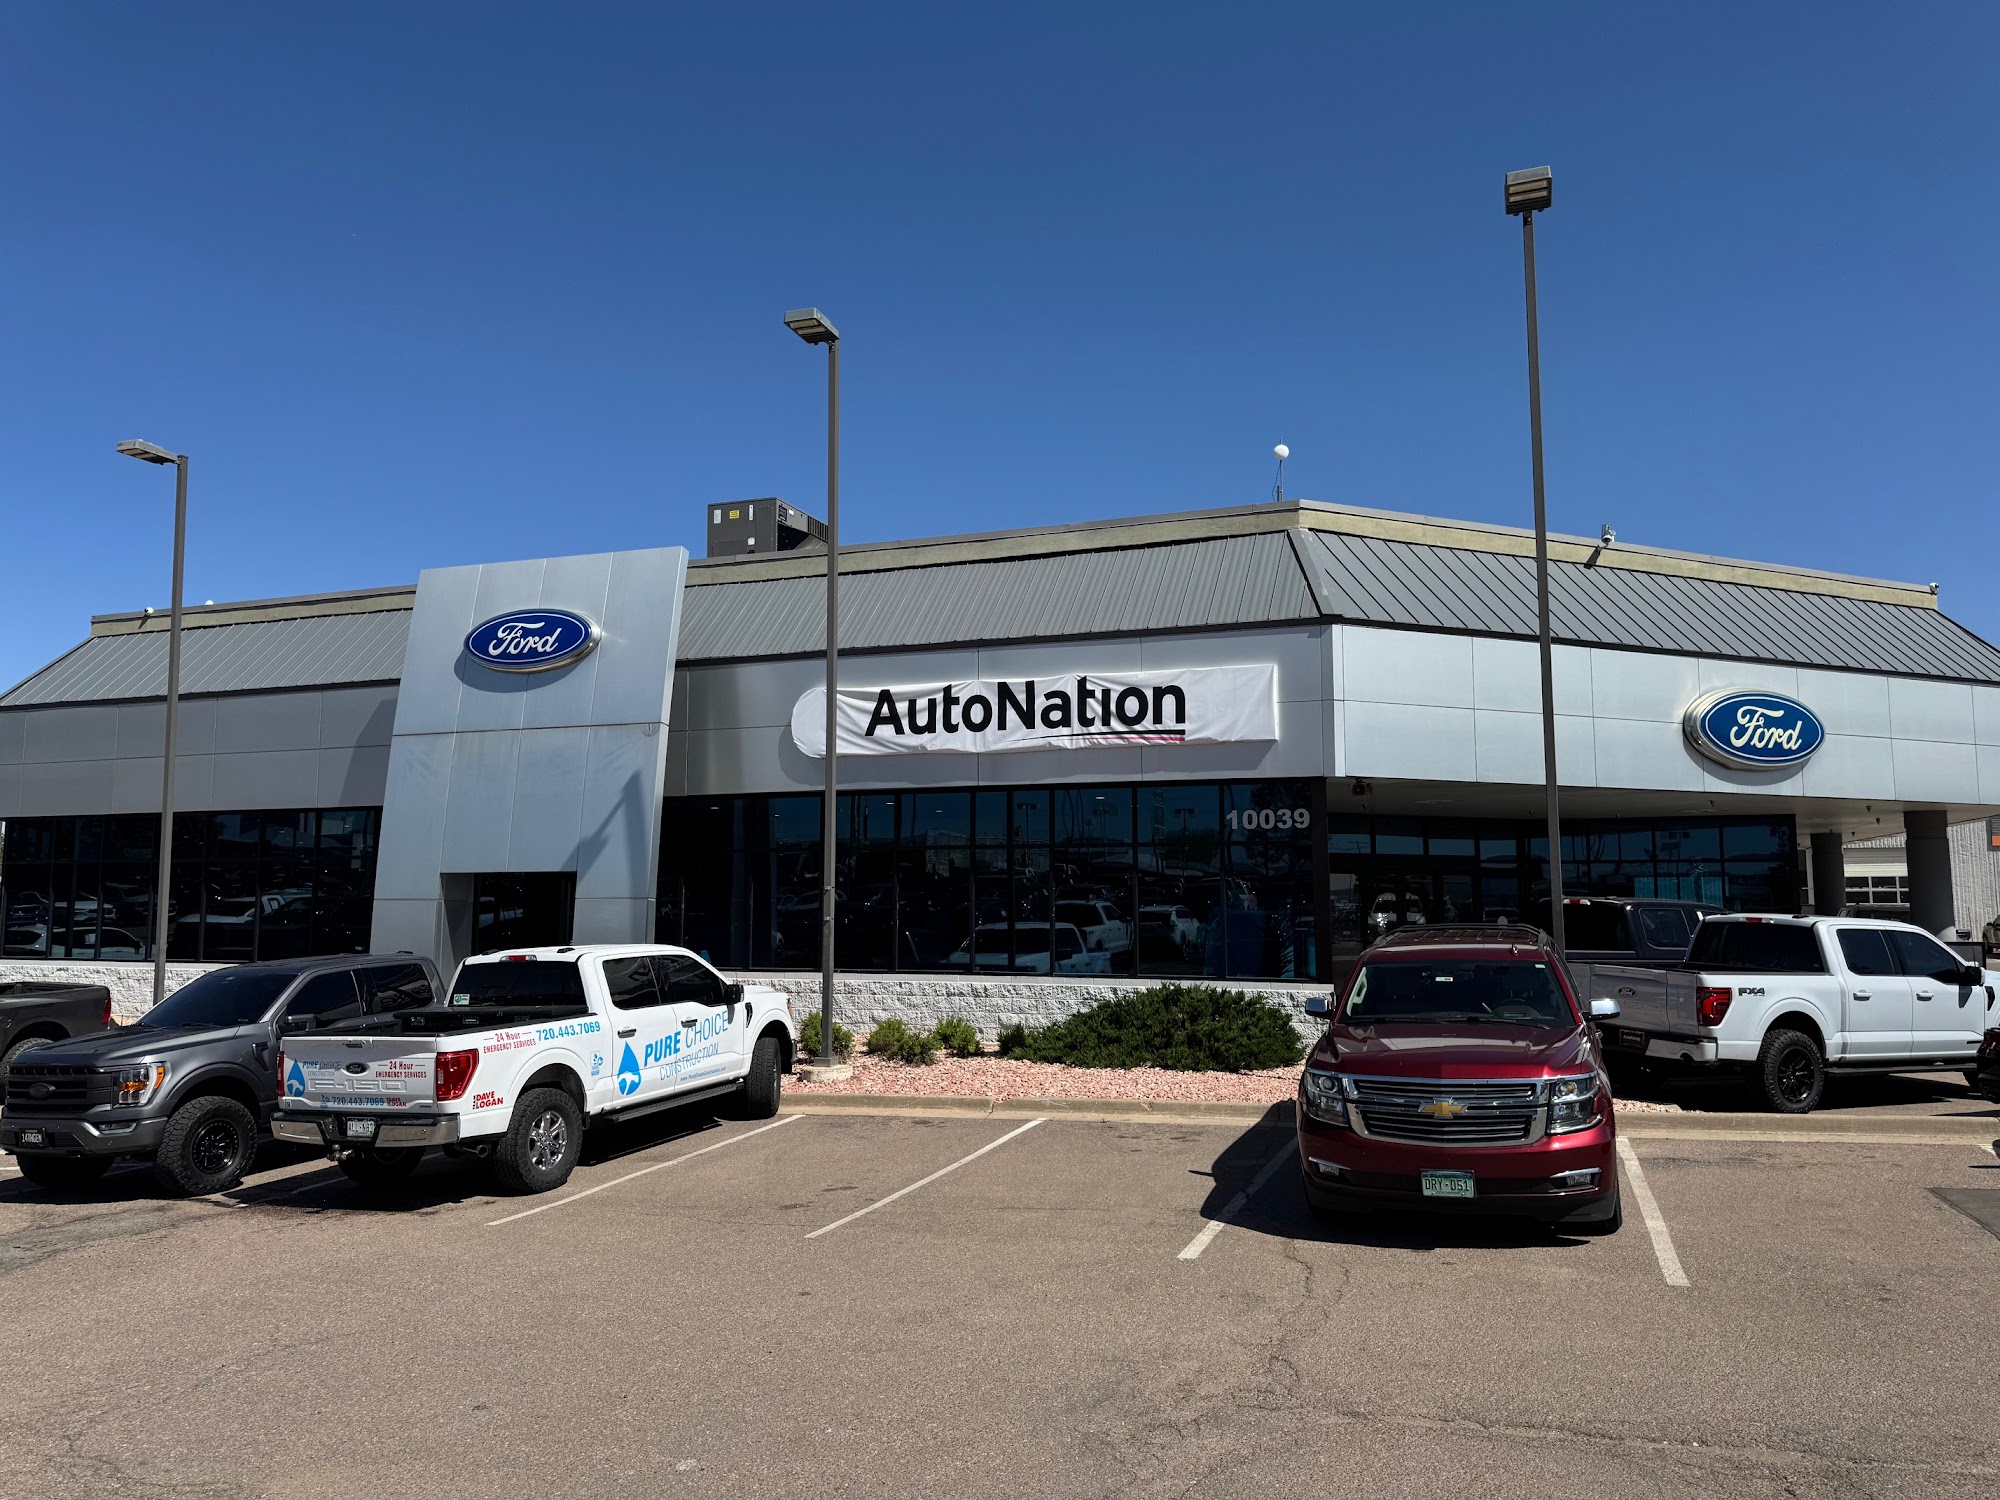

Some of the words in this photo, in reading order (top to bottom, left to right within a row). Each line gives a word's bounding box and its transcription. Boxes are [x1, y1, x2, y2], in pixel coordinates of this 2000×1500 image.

[488, 621, 562, 656] Ford
[864, 674, 1186, 737] AutoNation
[1729, 705, 1802, 751] Ford
[1226, 808, 1311, 830] 10039
[1738, 987, 1766, 997] FX4
[495, 1033, 505, 1043] 24
[506, 1031, 521, 1041] Hour
[536, 1021, 601, 1041] 720.443.7069
[483, 1043, 512, 1054] EMERGENCY
[513, 1038, 537, 1049] SERVICES
[643, 1030, 681, 1068] PURE
[685, 1010, 729, 1049] CHOICE
[302, 1060, 319, 1069] PURE
[318, 1060, 342, 1070] CHOICE
[389, 1060, 399, 1070] 24
[399, 1061, 414, 1070] Hour
[660, 1041, 720, 1081] CONSTRUCTION
[375, 1070, 403, 1078] EMERGENCY
[403, 1071, 427, 1079] SERVICES
[308, 1078, 408, 1093] F-150
[332, 1096, 385, 1107] 720.443.7069
[475, 1097, 504, 1109] LOGAN
[476, 1091, 495, 1101] DAVE
